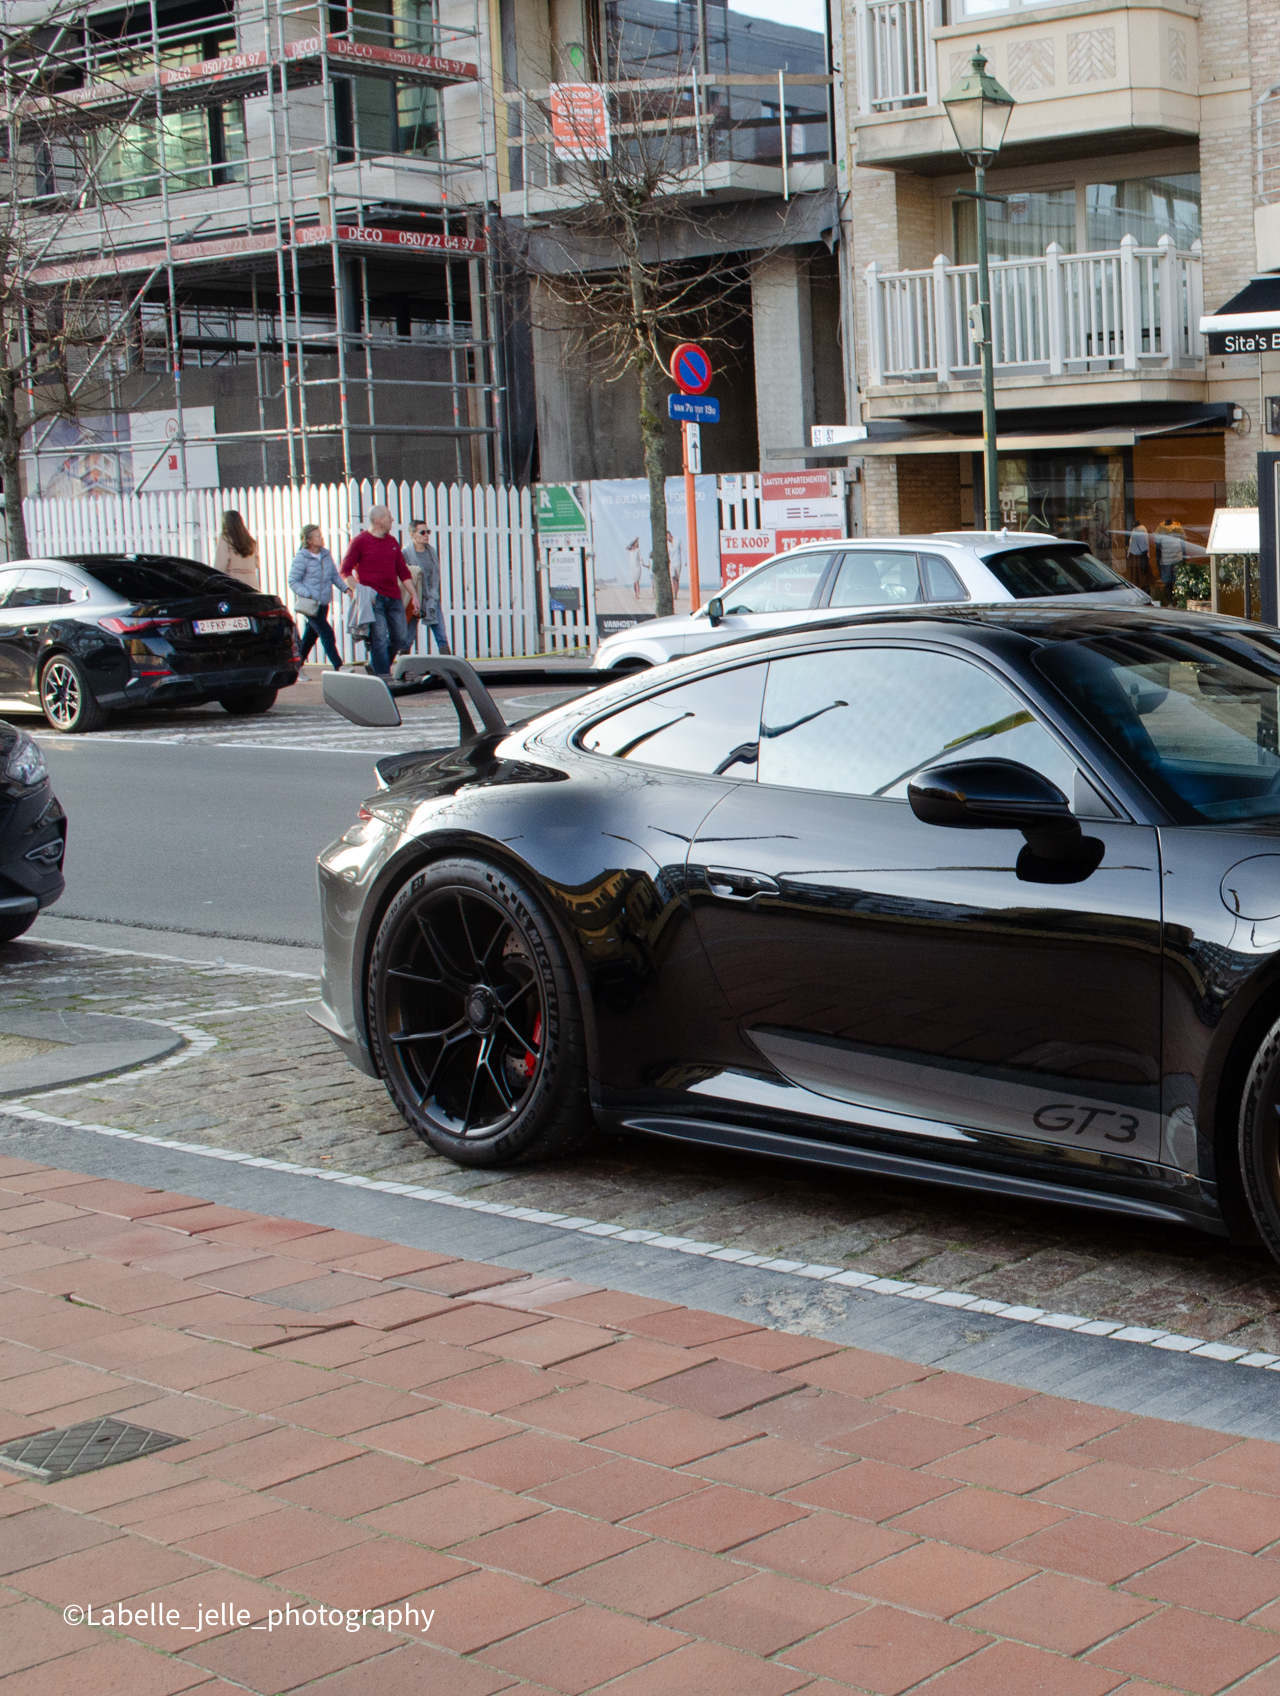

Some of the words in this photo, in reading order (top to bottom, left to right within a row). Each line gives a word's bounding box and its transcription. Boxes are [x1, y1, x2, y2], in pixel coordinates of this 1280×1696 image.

[291, 38, 318, 55] DECO
[338, 40, 373, 58] DECO
[452, 61, 466, 74] 97
[167, 65, 191, 83] DECO
[248, 52, 260, 66] 97
[302, 227, 327, 241] DECO
[348, 227, 383, 243] DECO
[399, 232, 442, 248] 050/22
[444, 236, 459, 249] 04
[462, 238, 476, 250] 97
[1224, 334, 1267, 352] Sita's
[673, 403, 685, 412] VAN
[694, 405, 704, 414] TOT
[763, 477, 784, 486] LAATSTE
[784, 475, 827, 484] APPARTEMENTEN
[784, 487, 791, 495] TE
[791, 486, 806, 496] KOOP
[602, 495, 615, 505] WE
[615, 494, 638, 504] BUILD
[1003, 510, 1017, 523] LE
[725, 537, 739, 549] TE
[741, 536, 770, 549] KOOP
[528, 928, 559, 1035] MICHELIN
[1032, 1103, 1140, 1144] GT3
